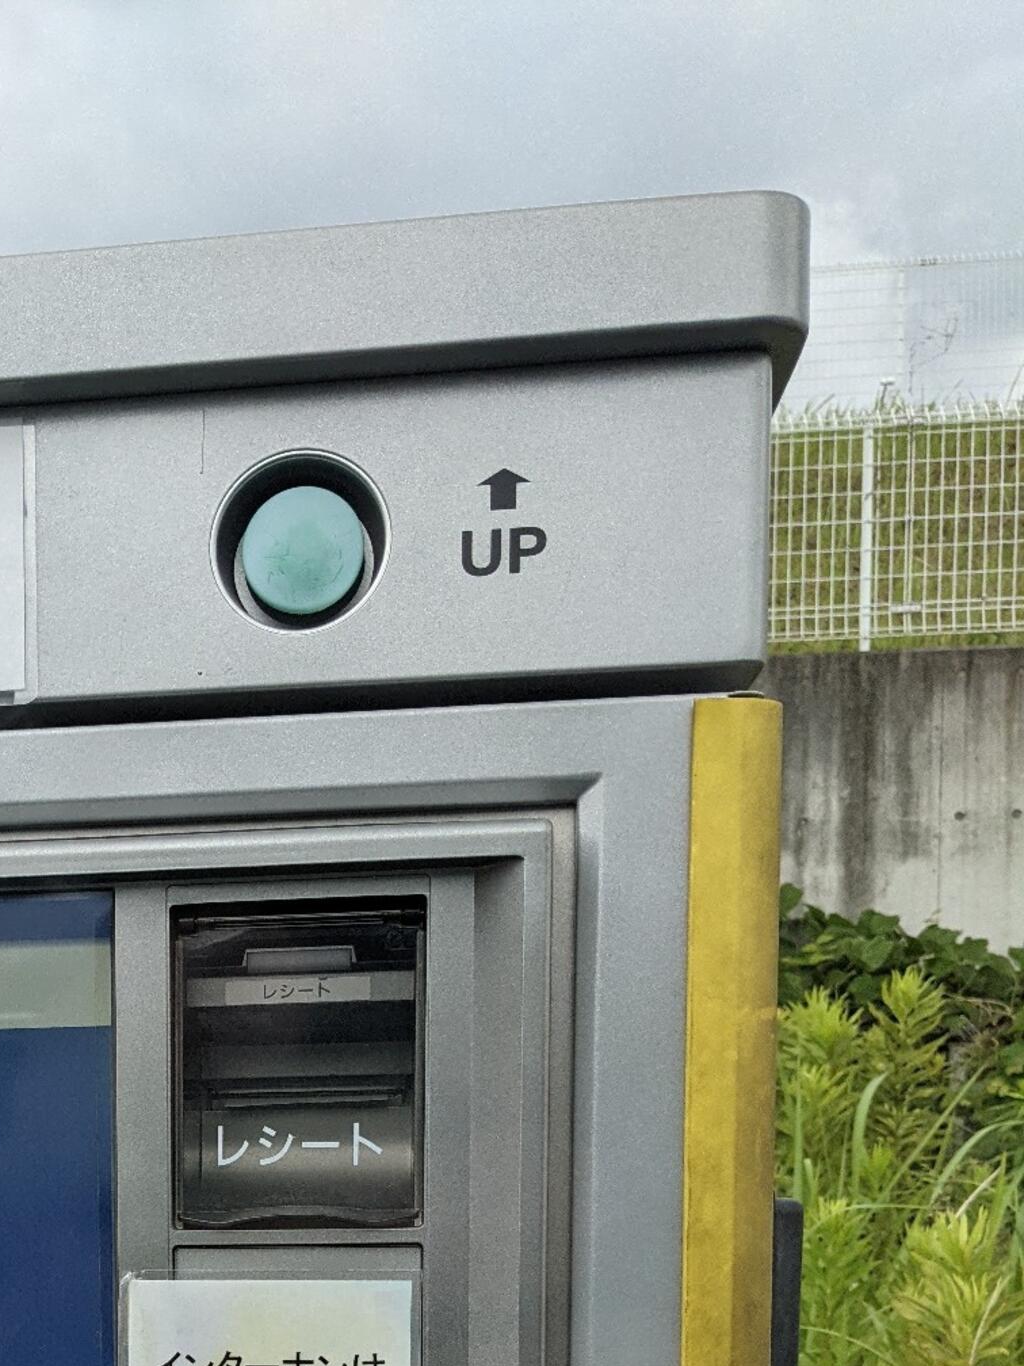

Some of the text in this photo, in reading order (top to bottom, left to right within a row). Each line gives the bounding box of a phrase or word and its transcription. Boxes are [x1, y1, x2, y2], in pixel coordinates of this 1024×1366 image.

[461, 526, 547, 577] UP
[263, 977, 331, 1000] レシート
[217, 1121, 383, 1167] レシート
